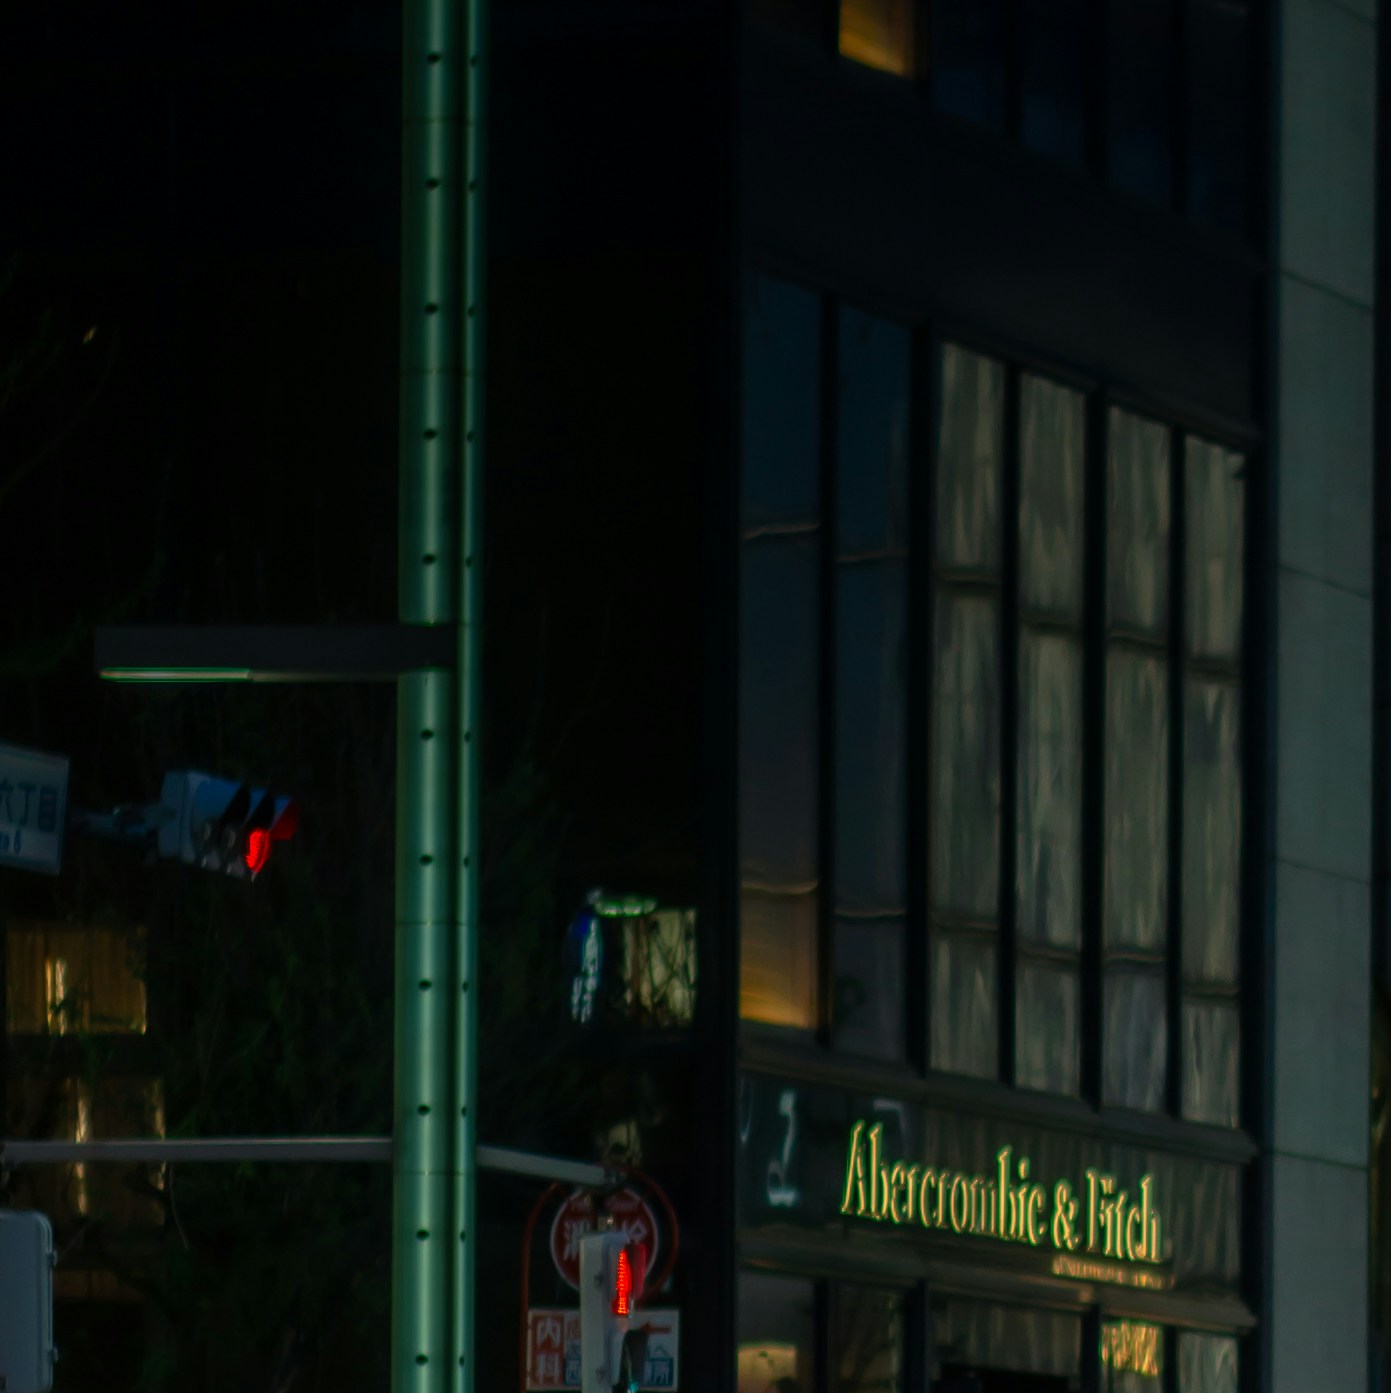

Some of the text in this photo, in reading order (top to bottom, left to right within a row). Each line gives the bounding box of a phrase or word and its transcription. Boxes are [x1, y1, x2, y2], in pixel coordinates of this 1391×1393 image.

[840, 1118, 1048, 1247] Abercrombie
[1050, 1177, 1081, 1251] &
[1085, 1165, 1164, 1264] Fitch
